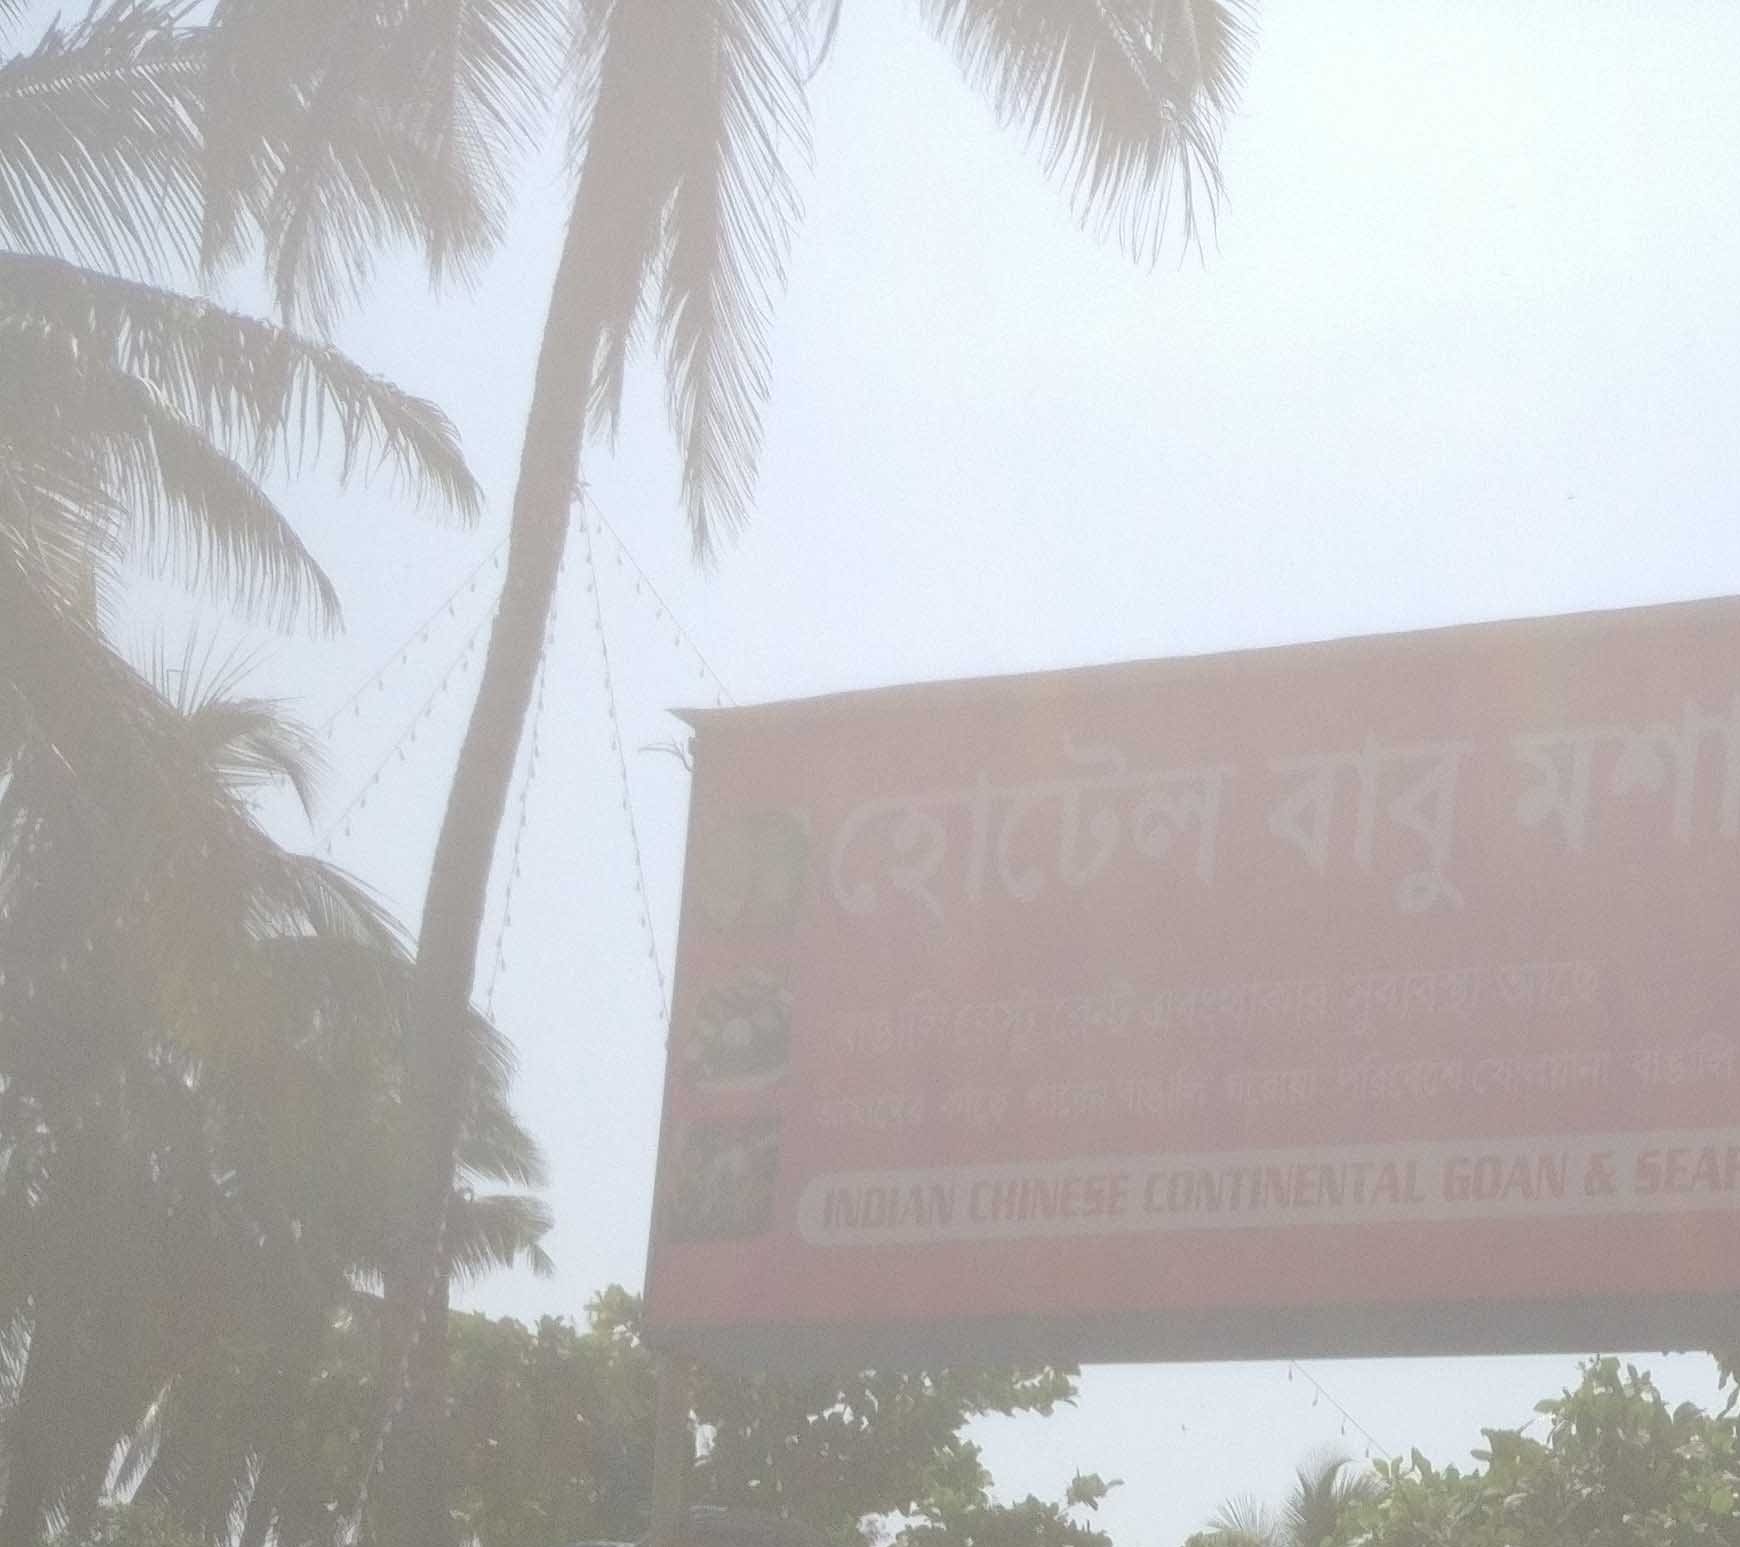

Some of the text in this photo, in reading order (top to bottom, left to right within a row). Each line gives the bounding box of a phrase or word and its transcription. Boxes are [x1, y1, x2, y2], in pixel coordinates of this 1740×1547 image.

[830, 733, 1236, 926] হোটেল
[1268, 733, 1474, 913] বাবু
[823, 1183, 956, 1229] INDIAN
[968, 1174, 1129, 1222] CHINESE
[1145, 1160, 1425, 1213] CONTINENTAL
[1443, 1153, 1568, 1203] GOAN
[1583, 1151, 1616, 1196] &
